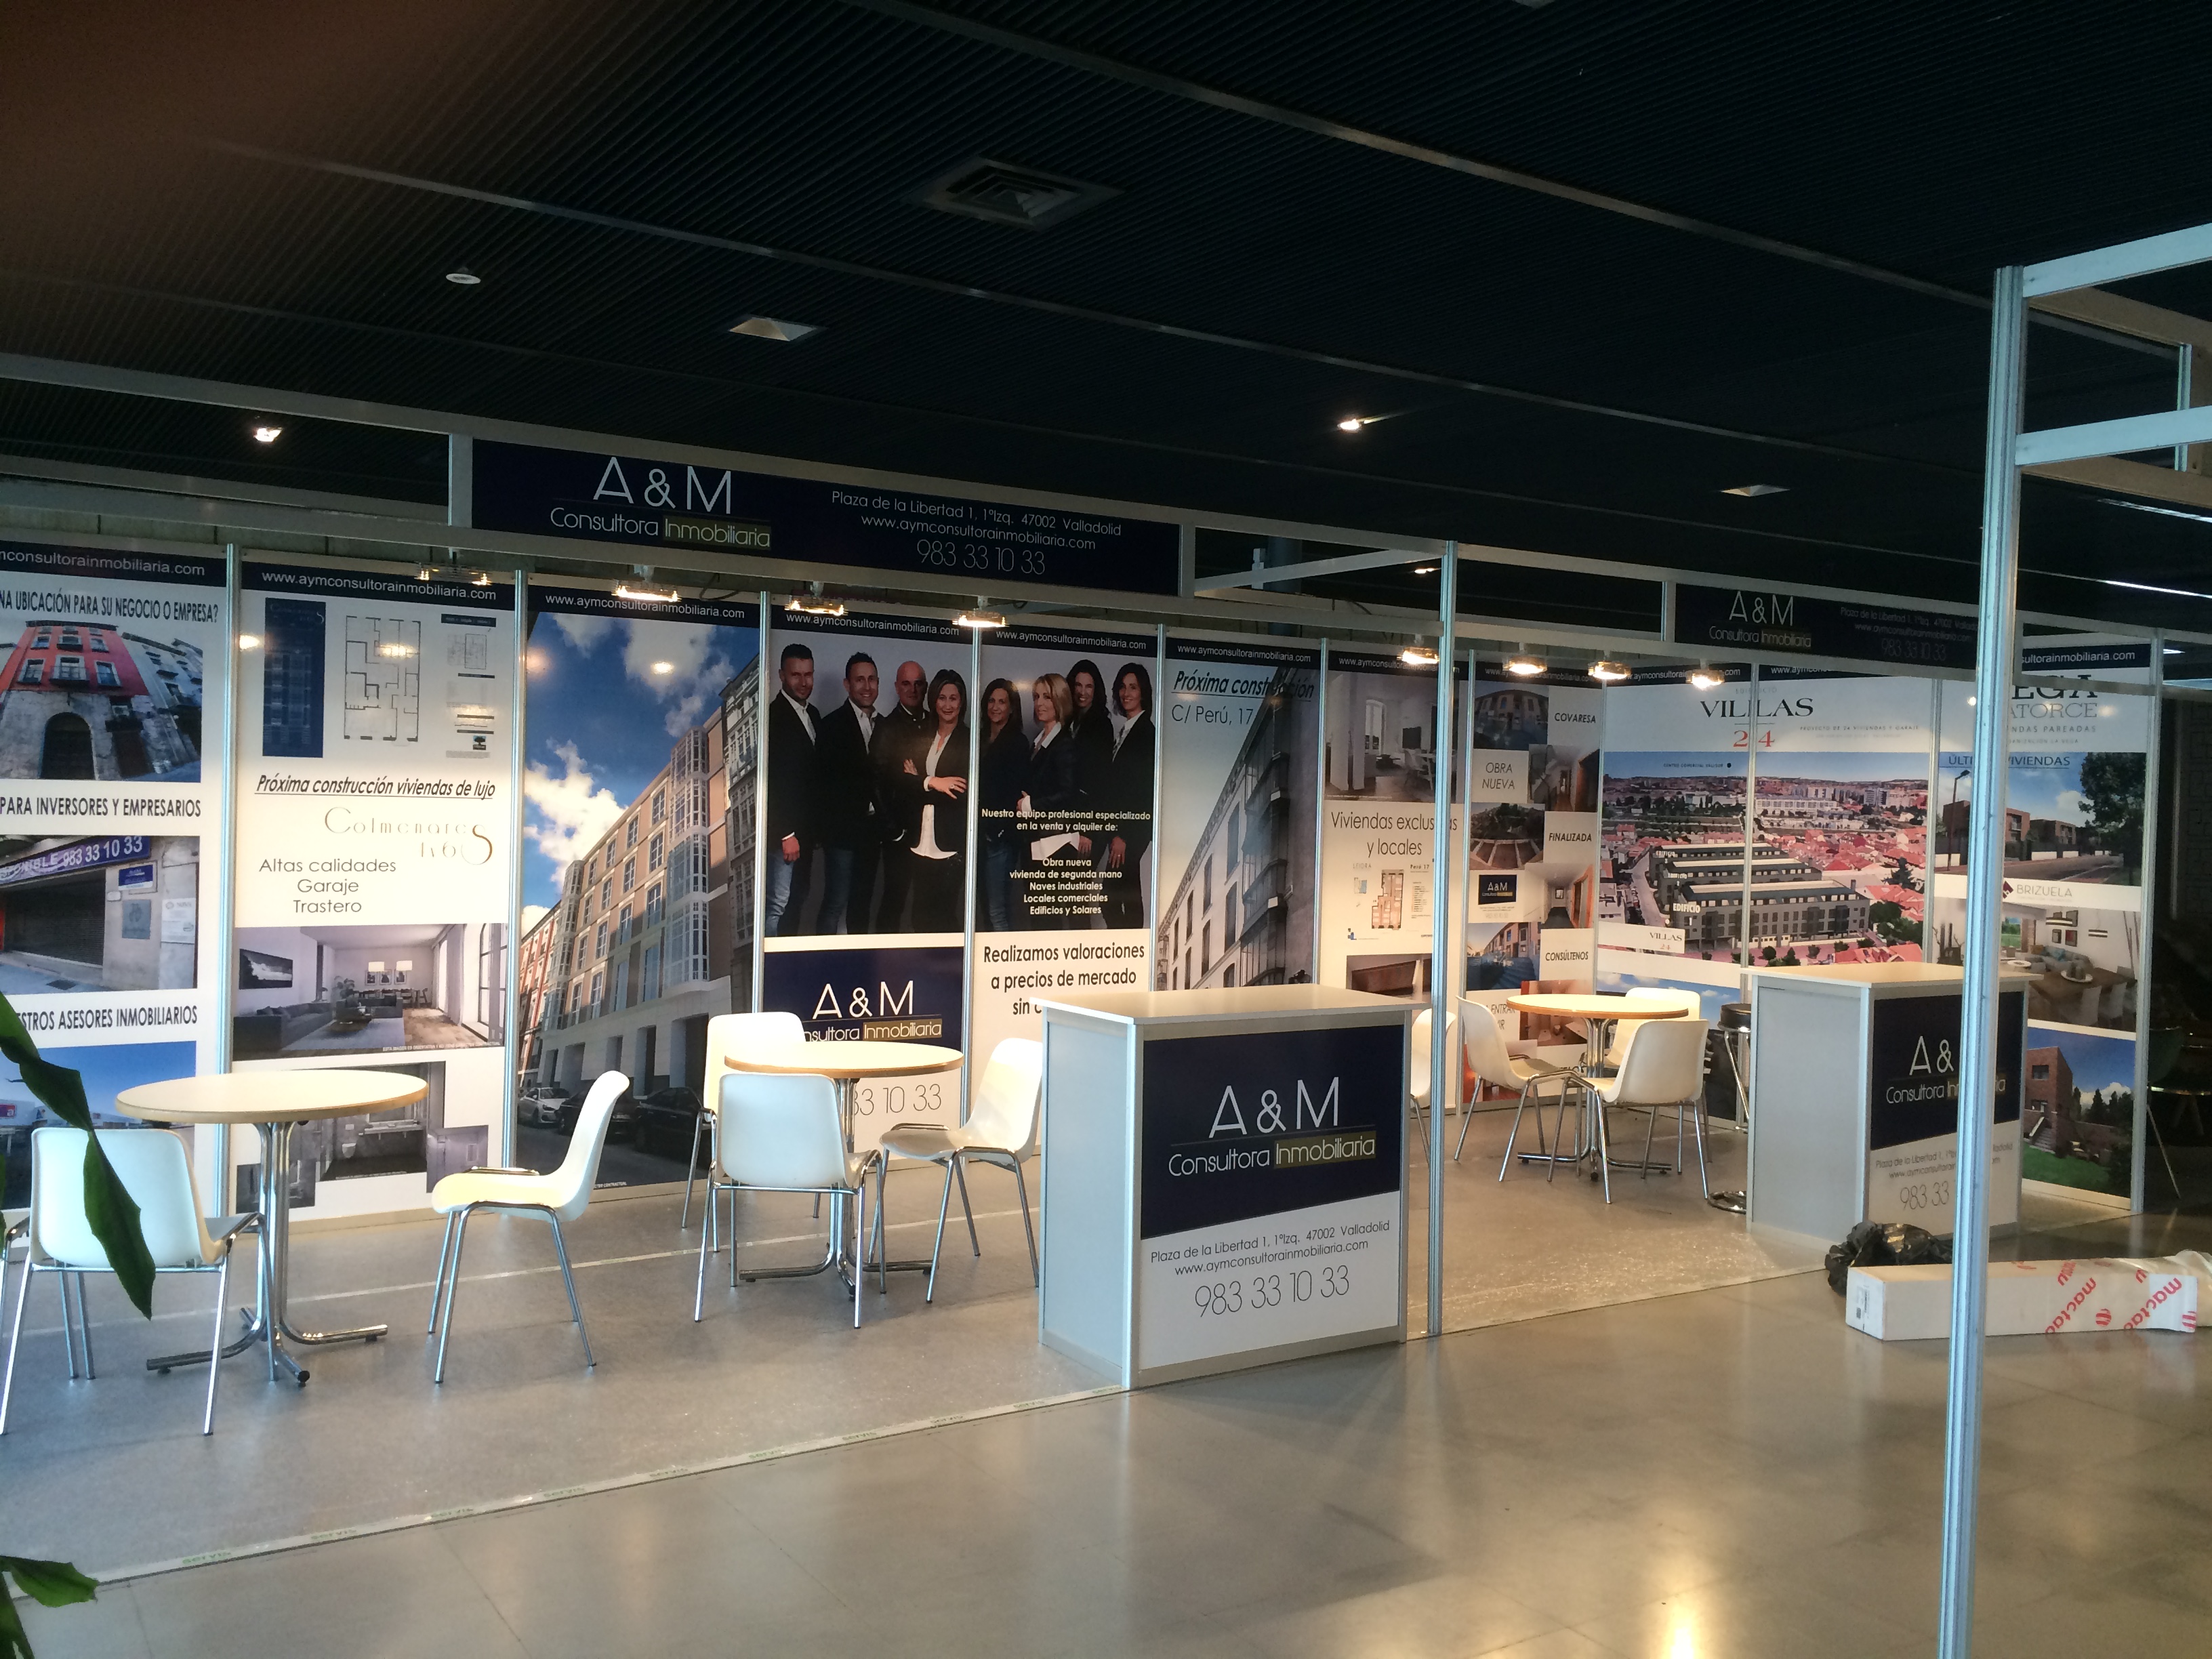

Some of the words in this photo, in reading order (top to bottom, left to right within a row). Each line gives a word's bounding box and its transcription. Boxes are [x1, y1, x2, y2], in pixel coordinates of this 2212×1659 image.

[593, 457, 634, 504] A
[644, 468, 676, 509] &
[687, 466, 731, 514] M
[832, 491, 868, 508] Plaza
[872, 495, 890, 510] de
[894, 498, 906, 512] la
[911, 499, 964, 518] Libertad
[1021, 514, 1056, 529] 47002
[1063, 518, 1122, 536] Valladolid
[550, 508, 658, 536] Consultora
[665, 518, 770, 547] Inmobiliaria
[861, 514, 1096, 550] www.aymconsultorainmobiliaria.com
[916, 539, 956, 567] 983
[963, 544, 989, 570] 33
[995, 547, 1014, 572] 10
[1021, 550, 1045, 575] 33
[262, 571, 496, 600] www.aymconsultorainmobiliaria.com
[16, 587, 70, 613] UBICACIÓN
[74, 594, 98, 615] PARA
[102, 596, 112, 615] SU
[115, 597, 161, 619] NEGOCIO
[163, 601, 171, 619] O
[173, 602, 218, 623] EMPRESA?
[545, 594, 745, 619] www.aymconsultorainmobiliaria.com
[1729, 591, 1748, 621] A
[1752, 597, 1767, 623] &
[1772, 594, 1793, 626] M
[1841, 607, 1858, 617] Plaza
[1879, 611, 1906, 622] Libertad
[786, 613, 960, 636] www.aymconsultorainmobiliaria.com
[996, 631, 1146, 649] www.aymconsultorainmobiliaria.com
[1709, 626, 1759, 642] Consultora
[1762, 630, 1811, 647] Inmobiliaria
[1178, 645, 1311, 662] www.aymconsultorainmobiliaria.com
[1882, 638, 1901, 657] 983
[1904, 640, 1917, 658] 33
[1921, 642, 1930, 659] 10
[1933, 644, 1946, 661] 33
[1174, 670, 1229, 693] Próxima
[1172, 704, 1191, 724] C/
[1196, 705, 1232, 726] Perú,
[1239, 708, 1253, 725] 17
[1554, 713, 1596, 724] COVARESA
[1486, 762, 1513, 774] OBRA
[256, 773, 310, 794] Próxima
[312, 776, 393, 795] construcción
[397, 779, 453, 796] viviendas
[456, 780, 472, 796] de
[474, 780, 495, 800] lujo
[1482, 778, 1515, 790] NUEVA
[0, 796, 32, 815] PARA
[37, 797, 108, 815] INVERSORES
[112, 798, 119, 815] Y
[123, 799, 201, 817] EMPRESARIOS
[982, 808, 1014, 818] Nuestro
[1017, 810, 1046, 821] equipo
[1048, 810, 1093, 822] profesional
[1095, 811, 1150, 821] especializado
[1030, 821, 1038, 830] la
[1040, 823, 1063, 831] venta
[1073, 822, 1103, 834] alquiler
[1105, 823, 1118, 831] de:
[1331, 811, 1393, 830] Viviendas
[1549, 833, 1592, 842] FINALIZADA
[86, 844, 100, 862] 33
[104, 840, 120, 859] 10
[124, 836, 142, 855] 33
[1367, 842, 1374, 858] y
[1378, 838, 1422, 855] locales
[259, 859, 303, 872] Altas
[309, 858, 396, 872] calidades
[1042, 858, 1064, 866] Obra
[1010, 870, 1046, 879] vivienda
[1048, 870, 1059, 878] de
[1061, 871, 1097, 880] segunda
[297, 878, 359, 895] Garaje
[1030, 882, 1056, 890] Naves
[1058, 882, 1103, 890] industriales
[2017, 884, 2072, 897] BRIZUELA
[293, 899, 362, 914] Trastero
[1023, 894, 1055, 903] Locales
[1058, 893, 1108, 902] comerciales
[1673, 903, 1700, 913] EDIFICIO
[1030, 905, 1063, 914] Edificios
[1072, 905, 1101, 914] Solares
[1650, 932, 1682, 941] VILLAS
[984, 944, 1059, 962] Realizamos
[1063, 943, 1145, 960] valoraciones
[1546, 949, 1589, 961] CONSÚLTENOS
[991, 977, 1000, 989] a
[1004, 970, 1052, 993] precios
[1057, 970, 1073, 987] de
[1078, 968, 1136, 985] mercado
[813, 983, 842, 1019] A
[849, 987, 872, 1017] &
[880, 981, 914, 1016] M
[1012, 998, 1030, 1015] sin
[58, 1008, 112, 1029] ASESORES
[116, 1005, 197, 1027] INMOBILIARIOS
[864, 1021, 941, 1039] Inmobiliaria
[1909, 1036, 1931, 1076] A
[1937, 1040, 1954, 1073] &
[882, 1086, 905, 1113] 10
[913, 1084, 941, 1111] 33
[1886, 1084, 1944, 1104] Consultora
[1209, 1085, 1247, 1139] A
[1256, 1089, 1286, 1133] &
[1296, 1076, 1338, 1129] M
[1168, 1148, 1270, 1176] Consultora
[1276, 1135, 1376, 1165] Inmobiliaria
[1912, 1150, 1938, 1163] Libertad
[1900, 1184, 1927, 1210] 983
[1931, 1181, 1949, 1206] 33
[1151, 1249, 1181, 1263] Plaza
[1183, 1246, 1199, 1259] de
[1202, 1245, 1212, 1256] la
[1214, 1237, 1258, 1254] Libertad
[1306, 1227, 1335, 1241] 47002
[1340, 1220, 1390, 1236] Valladolid
[1174, 1240, 1368, 1275] www.aymconsultorainmobiliaria.com
[1195, 1280, 1242, 1318] 983
[1251, 1274, 1281, 1309] 33
[1290, 1270, 1312, 1303] 10
[1321, 1265, 1349, 1298] 33
